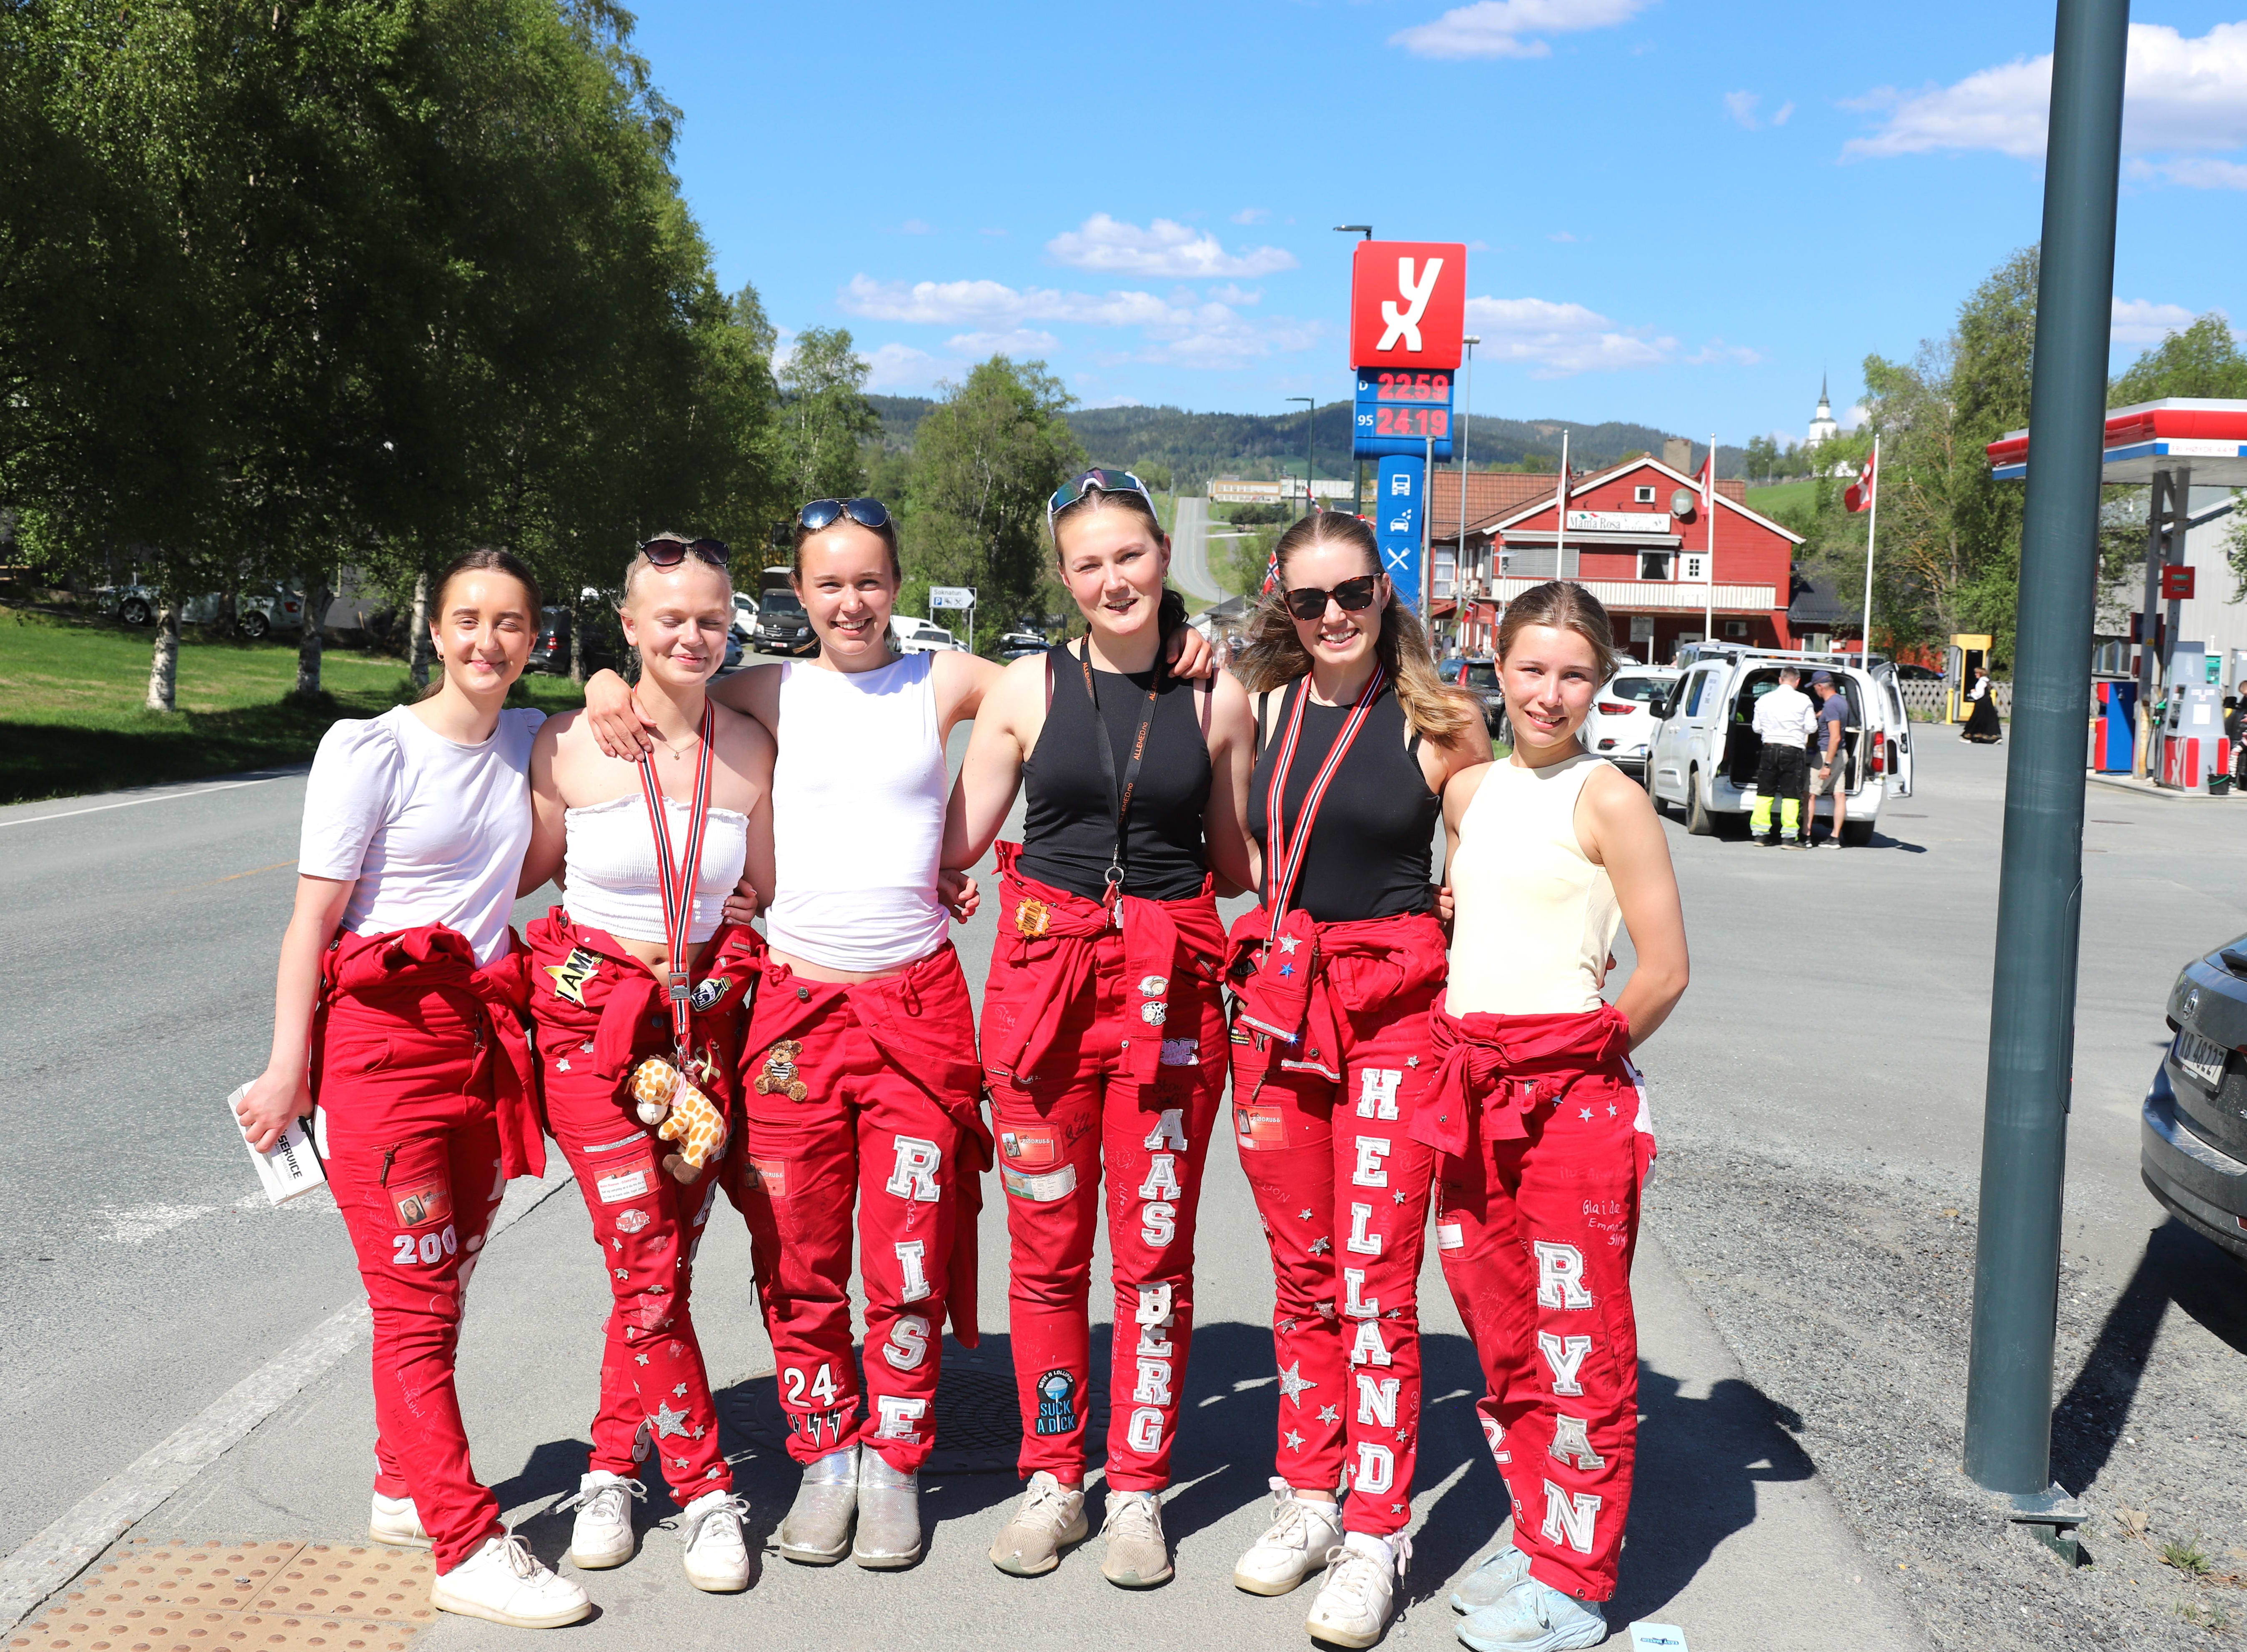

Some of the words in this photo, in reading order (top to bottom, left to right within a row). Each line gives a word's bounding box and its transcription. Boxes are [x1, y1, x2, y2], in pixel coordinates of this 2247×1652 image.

[1359, 381, 1368, 390] D
[1378, 373, 1448, 400] 22.59
[1358, 415, 1373, 426] 95
[1376, 408, 1448, 435] 24.19
[1570, 516, 1597, 528] Mama
[1600, 518, 1621, 529] Rosa
[1133, 721, 1148, 761] ALLEMED.no
[1022, 904, 1041, 931] WILD
[1036, 913, 1047, 932] CHILD
[278, 1135, 302, 1179] SERVICE
[874, 1134, 942, 1445] RISE
[1127, 1109, 1188, 1453] AASBERG
[1344, 1068, 1402, 1494] HELLAND
[784, 1364, 838, 1407] 24
[1053, 1369, 1074, 1384] LOLLIPOP
[1040, 1399, 1071, 1417] SUCK
[1533, 1240, 1606, 1554] RYAN
[1037, 1419, 1045, 1433] A
[1049, 1414, 1076, 1433] DICK
